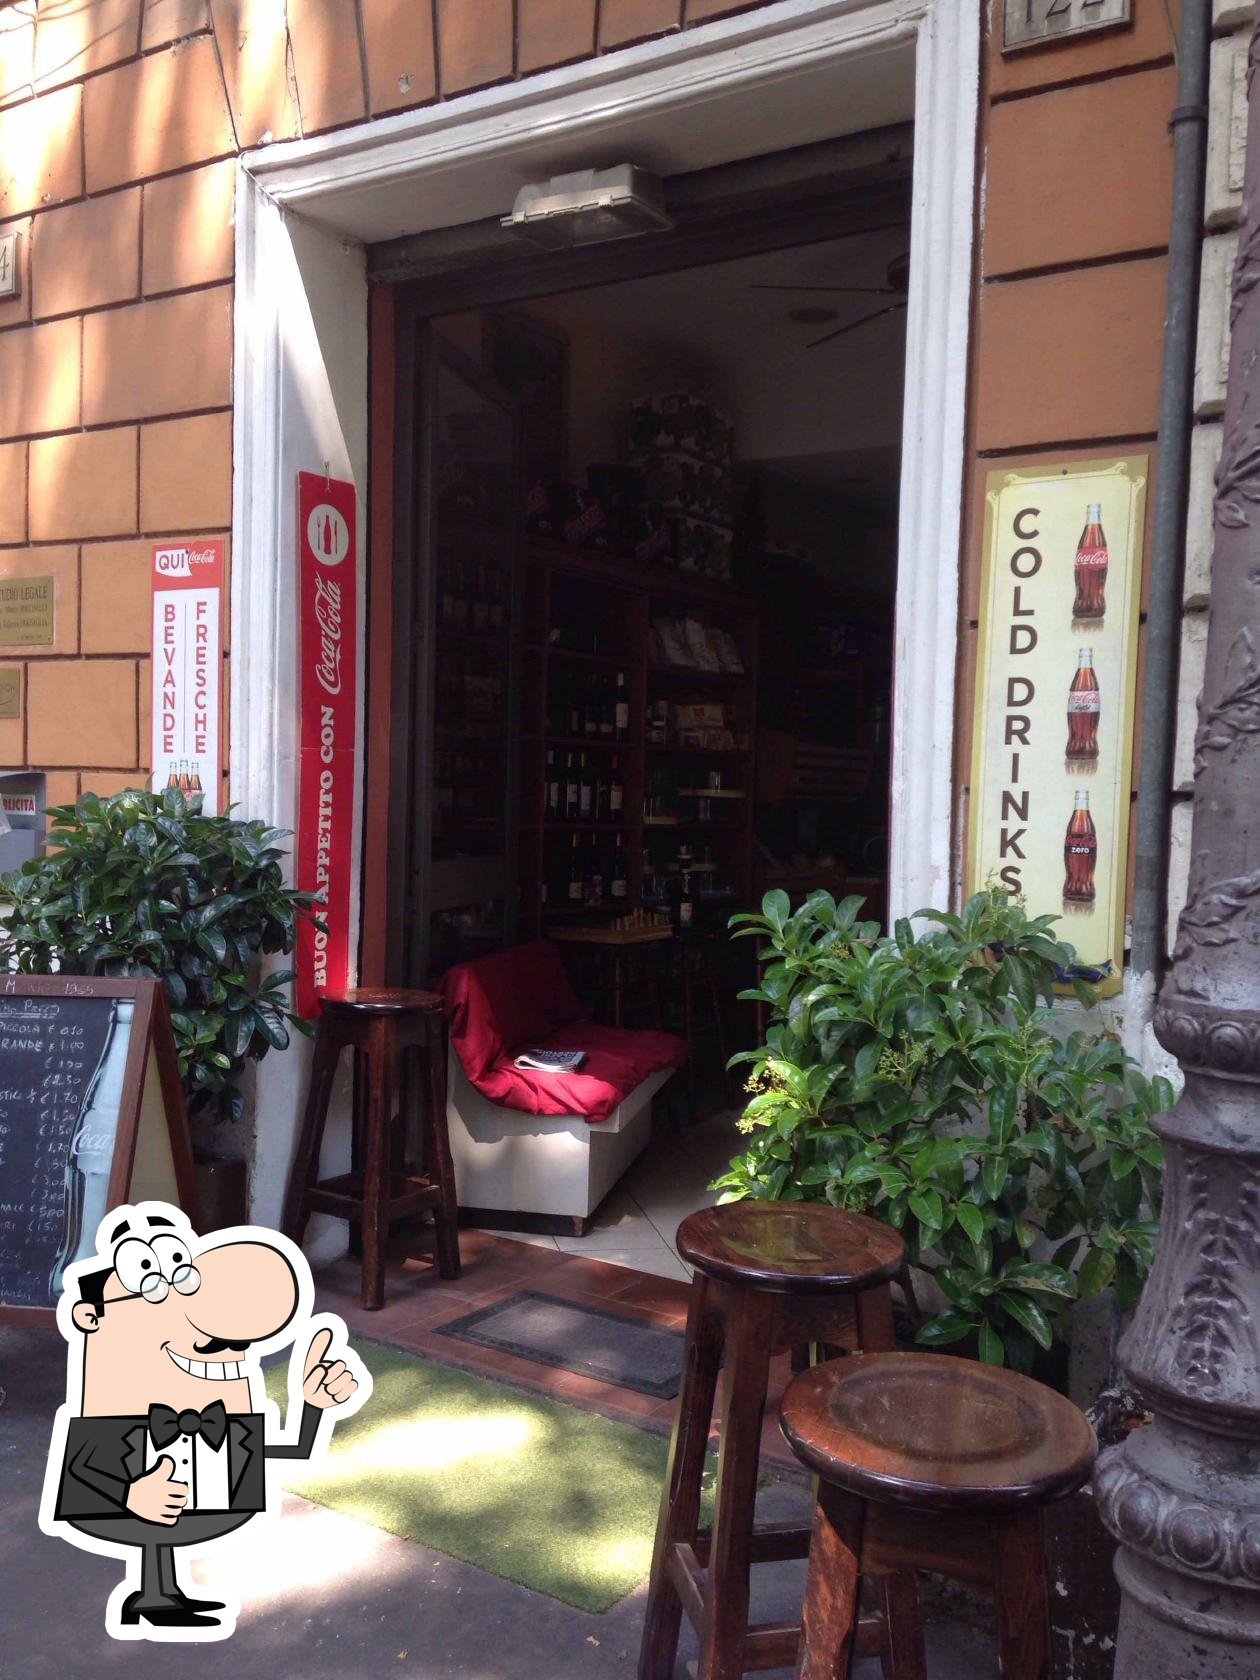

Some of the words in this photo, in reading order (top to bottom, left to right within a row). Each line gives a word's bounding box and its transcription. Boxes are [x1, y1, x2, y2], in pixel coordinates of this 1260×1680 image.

[158, 553, 185, 571] QUI
[1009, 507, 1043, 655] COLD
[163, 603, 176, 753] BEVANDE
[194, 601, 208, 754] FRESCHE
[315, 570, 342, 694] Coca-Cola
[320, 704, 336, 764] CON
[999, 676, 1036, 897] DRINKS
[316, 769, 334, 906] APPETITO
[1071, 846, 1090, 854] zero
[313, 910, 329, 988] BUON
